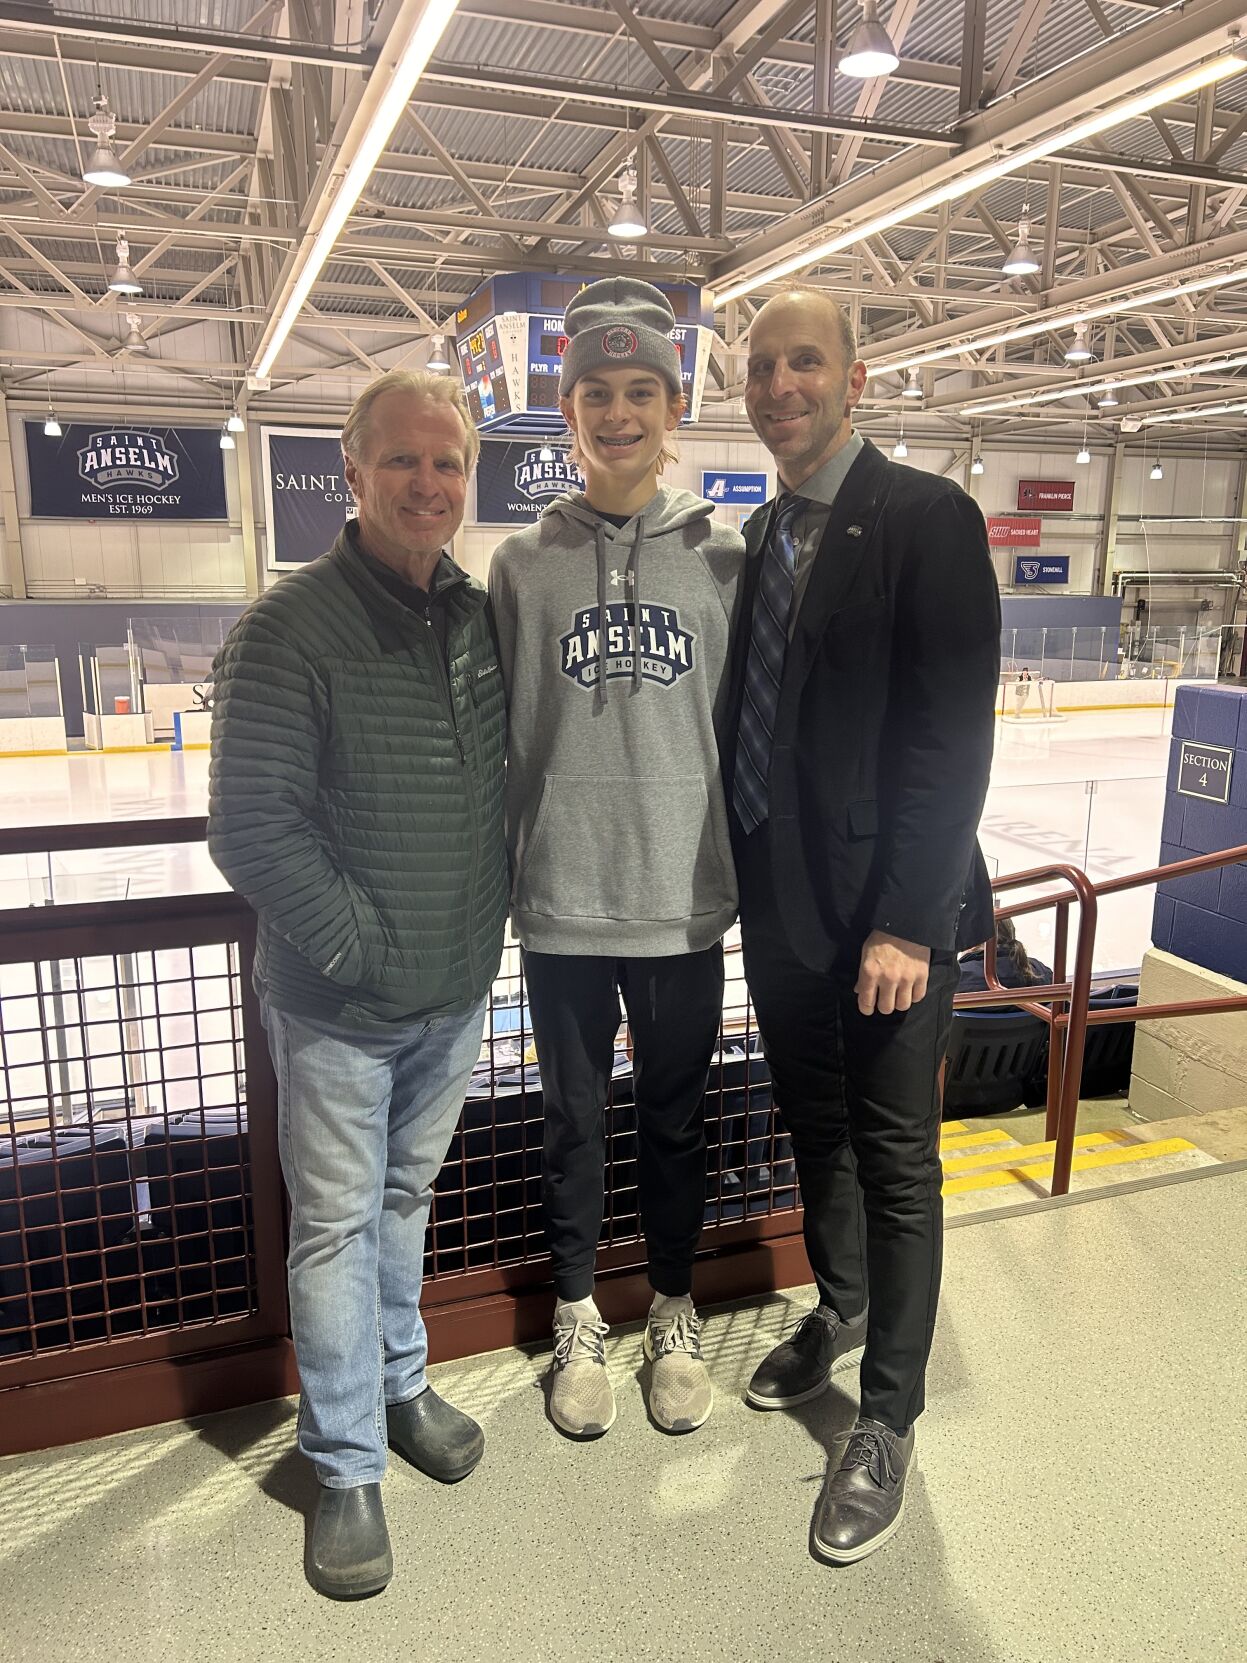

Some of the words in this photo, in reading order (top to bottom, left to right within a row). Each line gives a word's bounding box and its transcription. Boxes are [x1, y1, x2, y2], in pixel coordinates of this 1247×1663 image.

[543, 319, 565, 332] HOM
[530, 363, 549, 373] PLYR
[511, 353, 521, 412] HAWKS
[96, 435, 158, 449] SAINT
[84, 447, 174, 476] ANSELM
[106, 469, 154, 479] HAWKS
[276, 473, 339, 491] SAINT
[732, 485, 762, 493] ASSUMPTION
[81, 493, 113, 503] MEN'S
[116, 494, 134, 504] ICE
[137, 495, 181, 505] HOCKEY
[1038, 492, 1057, 500] FRANKLIN
[109, 504, 129, 514] EST.
[131, 505, 153, 514] 1969
[989, 526, 1010, 538] SHU
[565, 625, 689, 670] ANSELM
[615, 659, 667, 674] HOKEY
[1183, 753, 1228, 771] SECTION
[1198, 772, 1208, 787] 4
